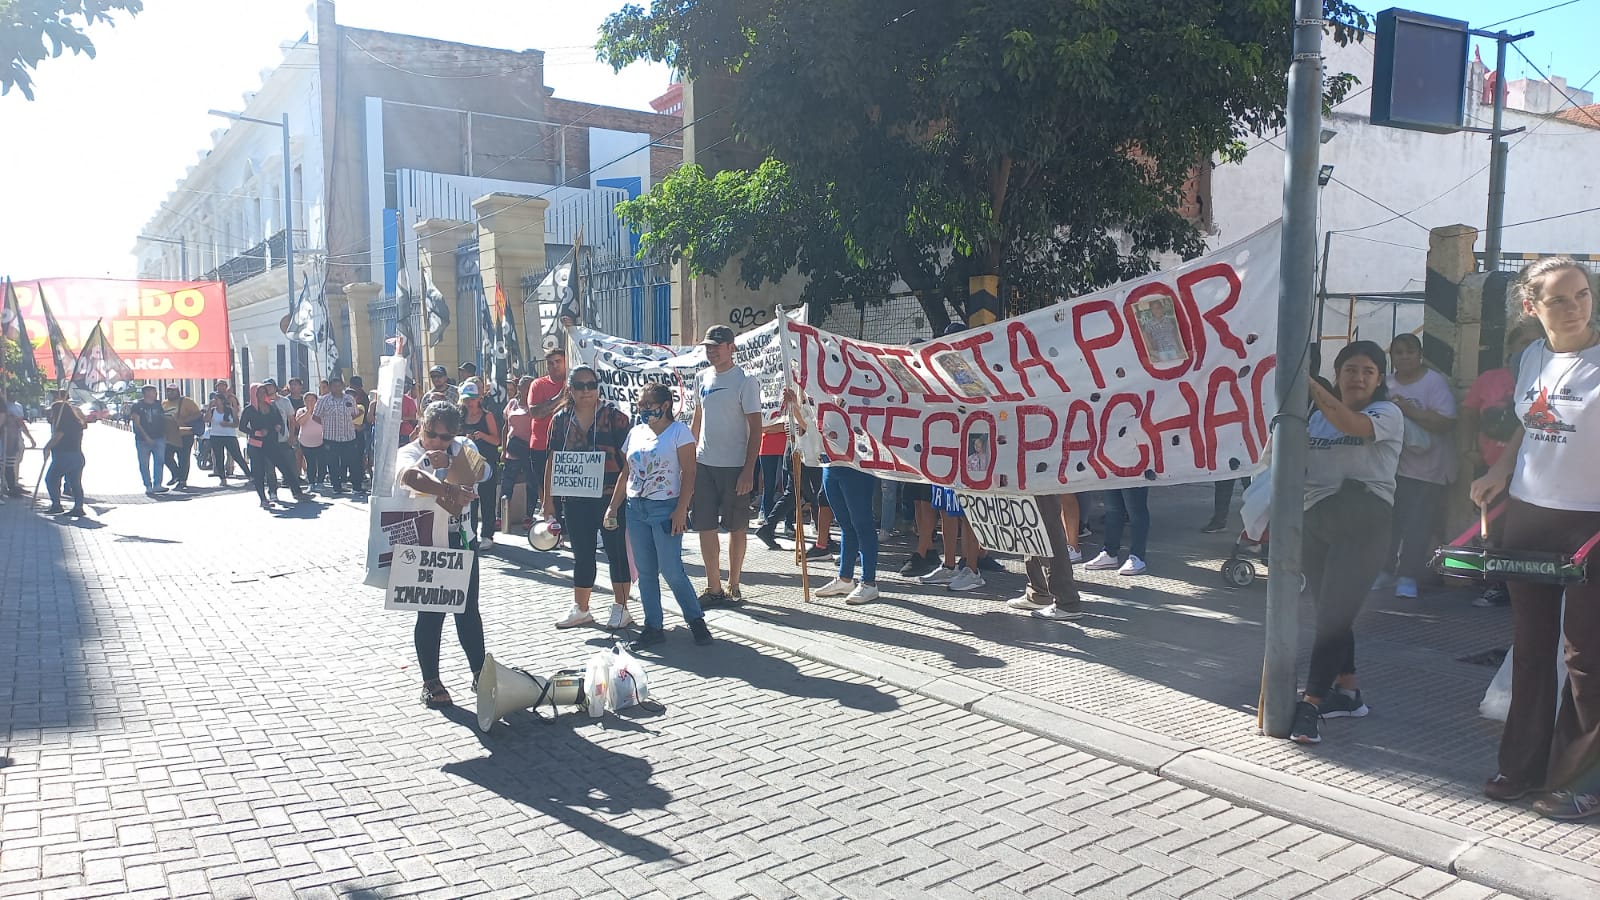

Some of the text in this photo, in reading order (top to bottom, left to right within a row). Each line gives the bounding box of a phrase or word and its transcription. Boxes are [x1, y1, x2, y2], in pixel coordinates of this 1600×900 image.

[787, 262, 1247, 405] JUSTICIA POR
[608, 386, 627, 401] LOS
[816, 402, 997, 490] DIEGO
[555, 453, 601, 464] DIEGO IVAN
[554, 464, 584, 475] PACHAO
[957, 493, 1039, 528] PROHIBIDO
[420, 550, 464, 570] BASTA
[1486, 559, 1556, 574] CATAMARCA
[418, 569, 434, 583] DE
